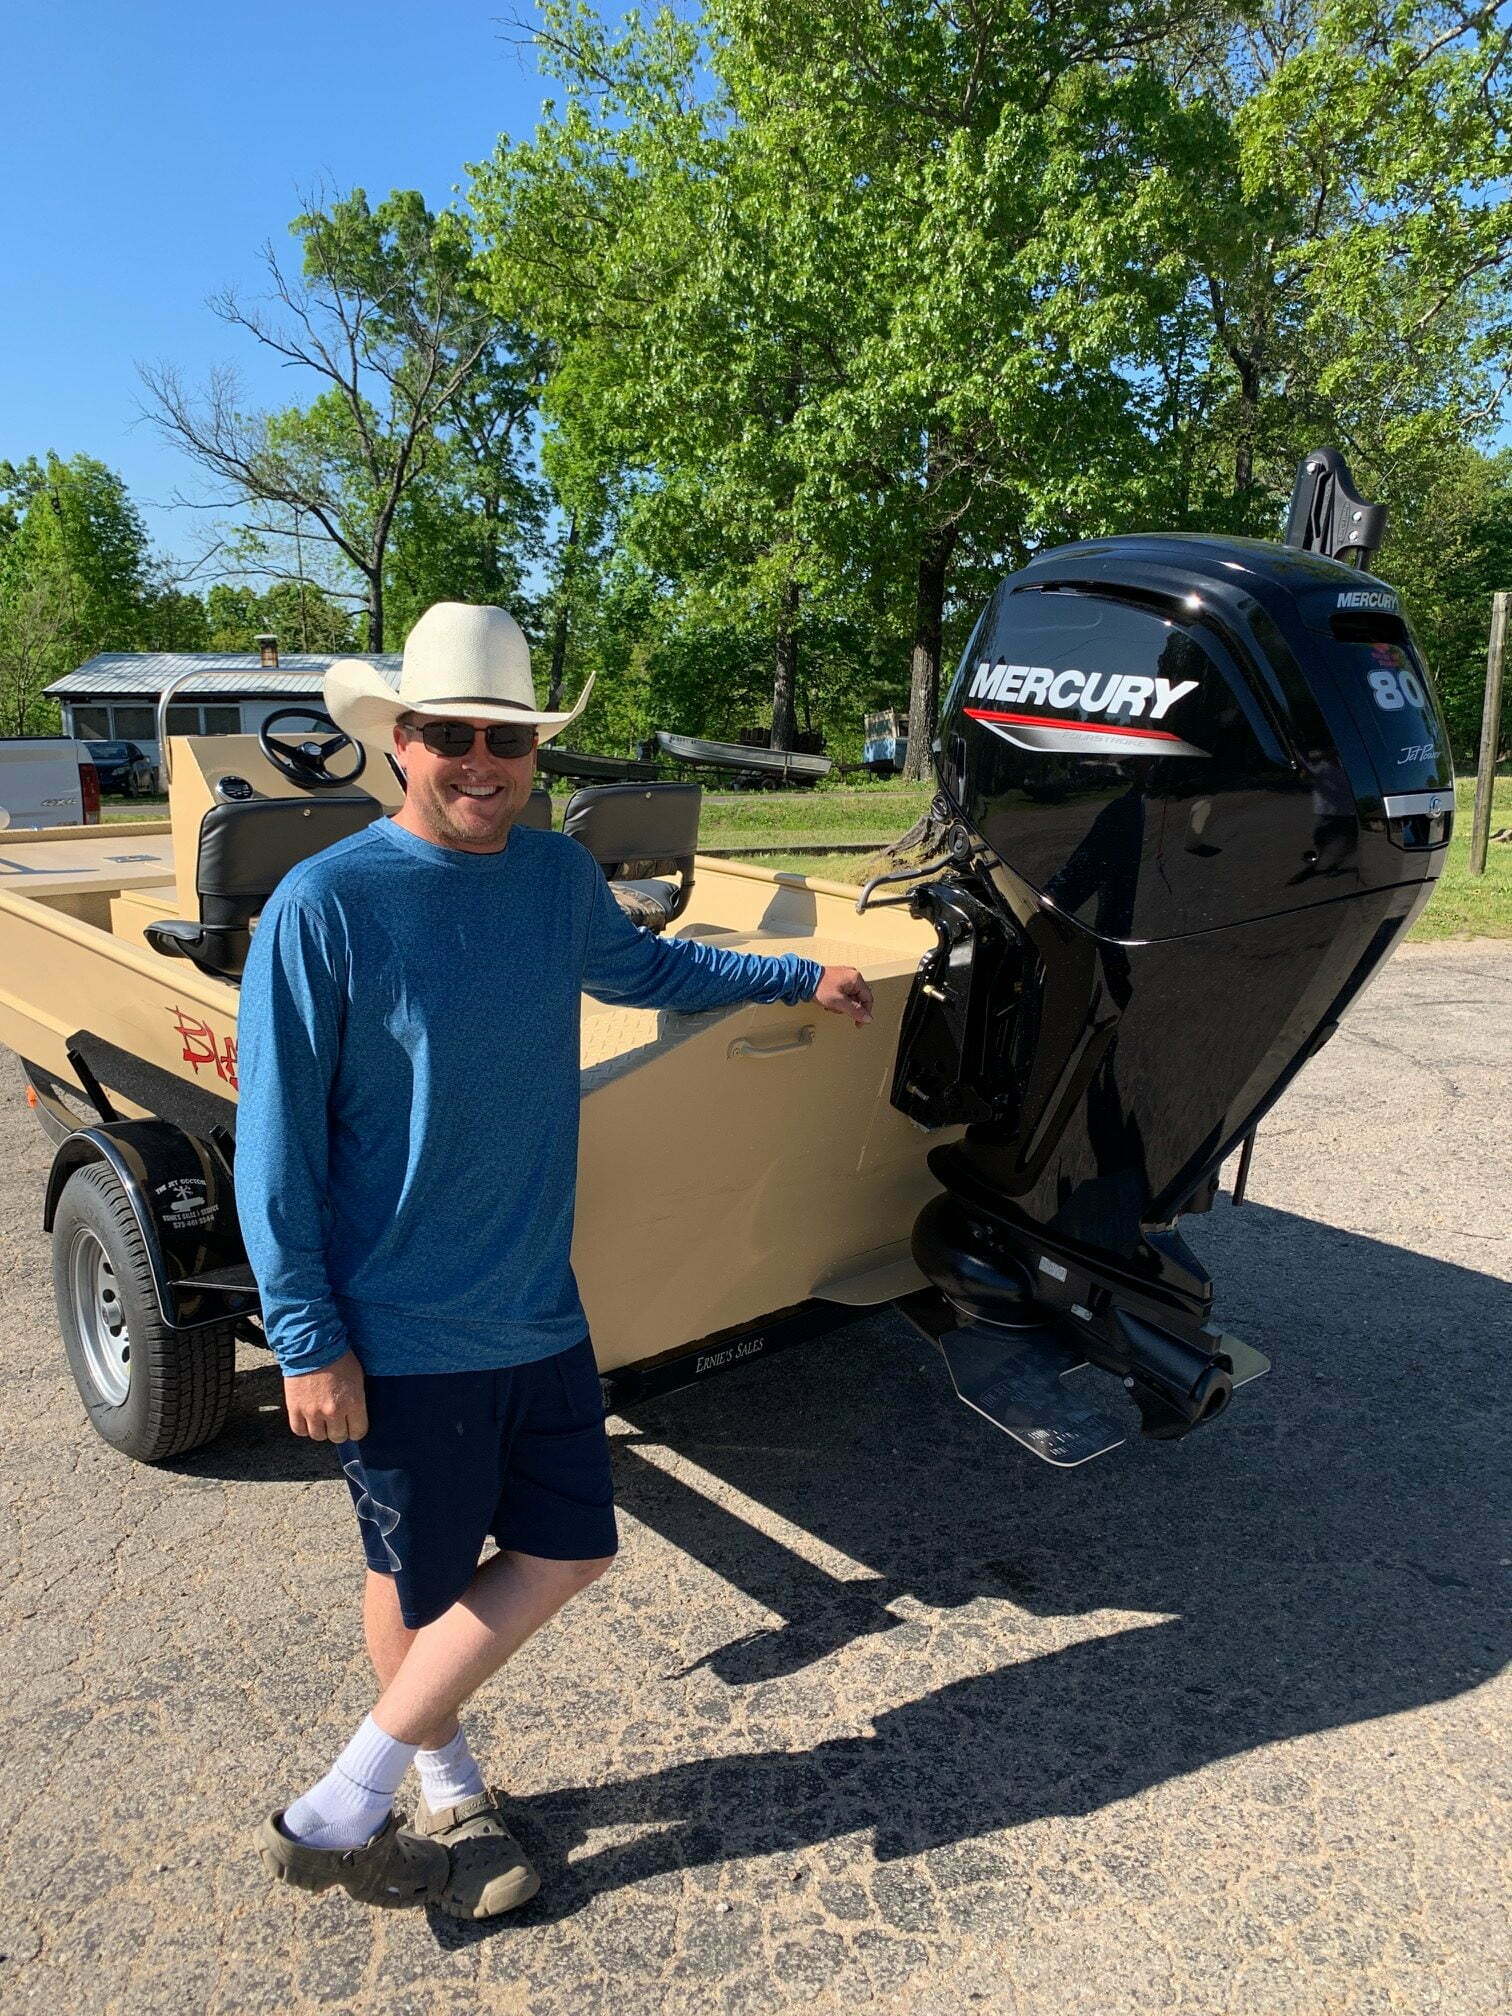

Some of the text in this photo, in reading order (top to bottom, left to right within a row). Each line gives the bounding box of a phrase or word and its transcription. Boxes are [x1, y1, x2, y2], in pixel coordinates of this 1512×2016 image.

[968, 663, 1200, 720] MERCURY
[1366, 669, 1425, 711] 80
[695, 1337, 765, 1374] ERNIE'S SALES
